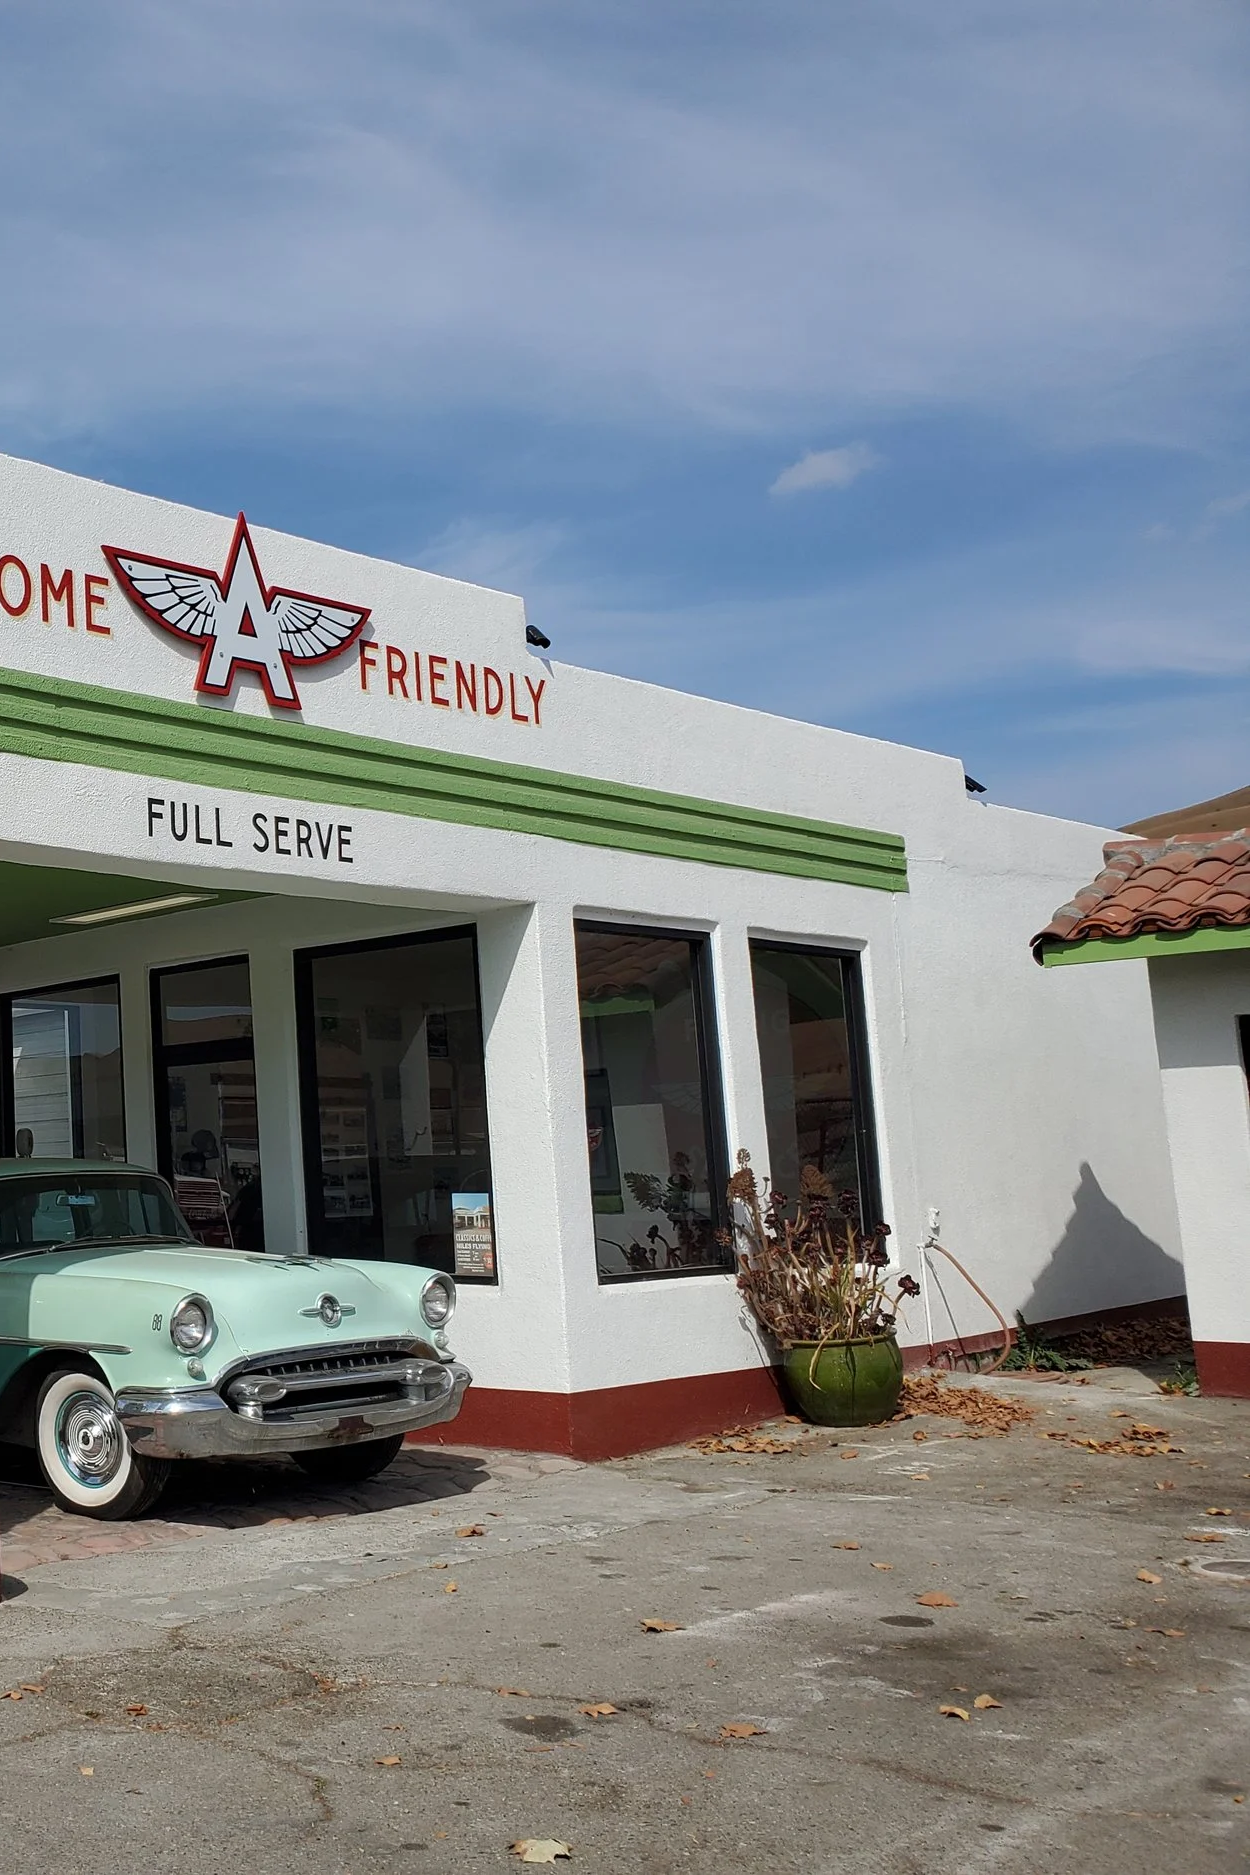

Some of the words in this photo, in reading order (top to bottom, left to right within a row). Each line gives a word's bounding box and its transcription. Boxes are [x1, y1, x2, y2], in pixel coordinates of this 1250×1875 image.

[358, 638, 546, 724] FRIENDLY
[147, 797, 233, 848] FULL
[251, 812, 354, 864] SERVE
[152, 1314, 163, 1331] 88
